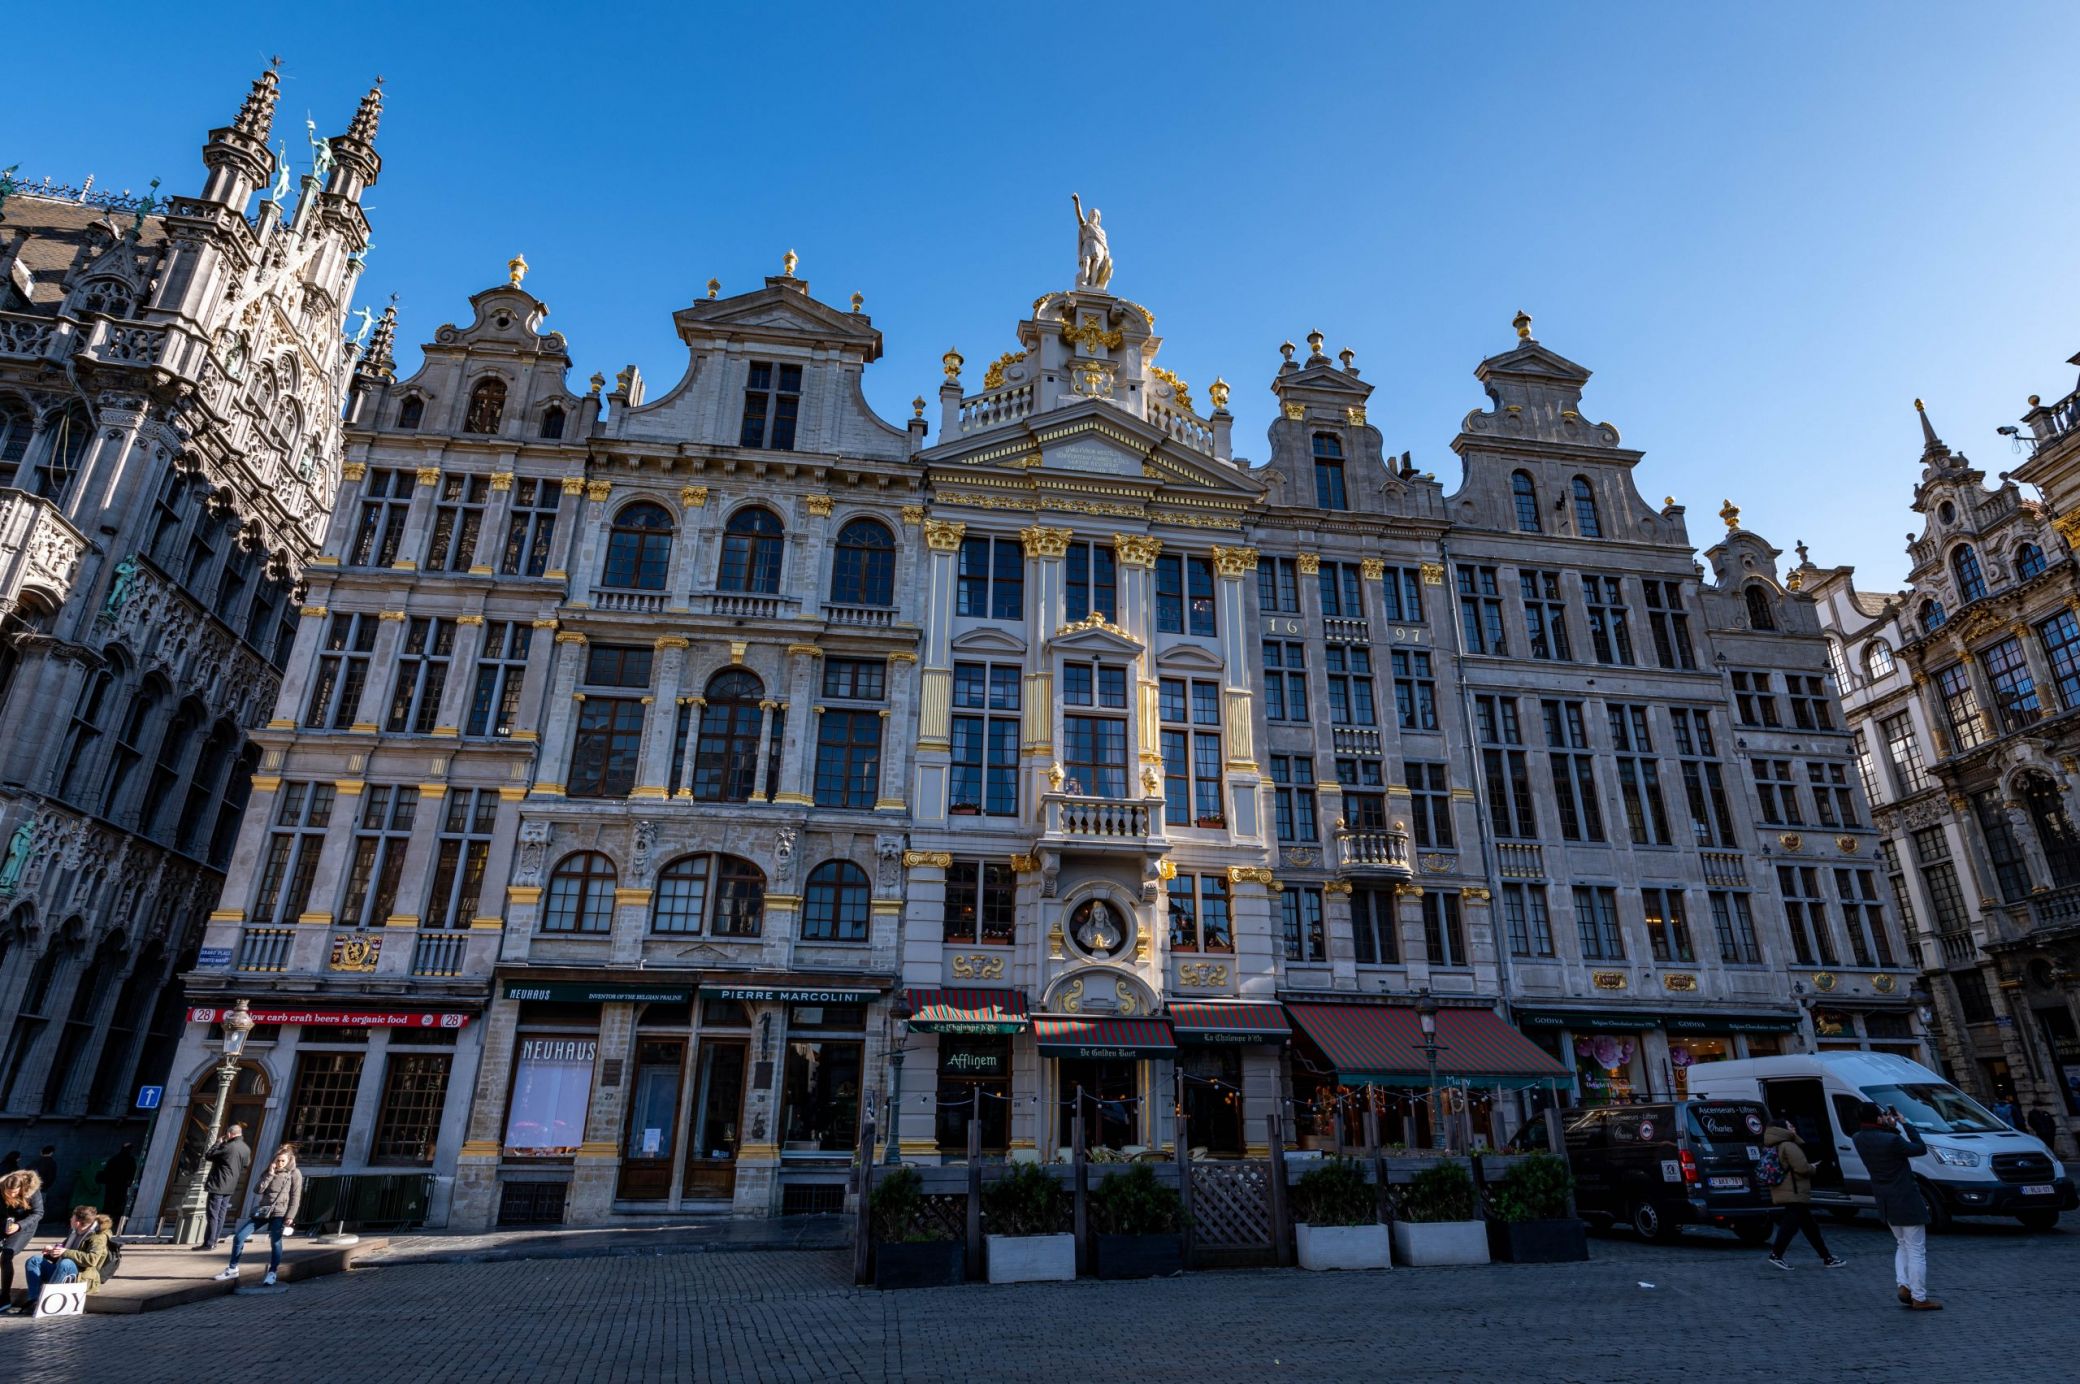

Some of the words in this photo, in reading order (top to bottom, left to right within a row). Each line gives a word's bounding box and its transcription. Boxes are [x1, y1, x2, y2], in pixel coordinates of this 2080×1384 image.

[509, 988, 551, 1000] NEUHAUS
[721, 990, 773, 1000] PIERRE
[780, 991, 859, 1002] MARCOLINI
[198, 1010, 212, 1021] 28
[266, 1012, 288, 1022] carb
[290, 1012, 313, 1023] craft
[315, 1013, 340, 1023] beers
[342, 1014, 351, 1023] &
[351, 1015, 386, 1026] organic
[387, 1015, 408, 1024] food
[445, 1015, 460, 1026] 28
[1534, 1017, 1564, 1025] GODIVA
[1678, 1020, 1706, 1028] GODIVA
[523, 1041, 596, 1061] NEUHAUS
[947, 1054, 997, 1069] Affligem
[1699, 1106, 1736, 1114] Ascenseurs
